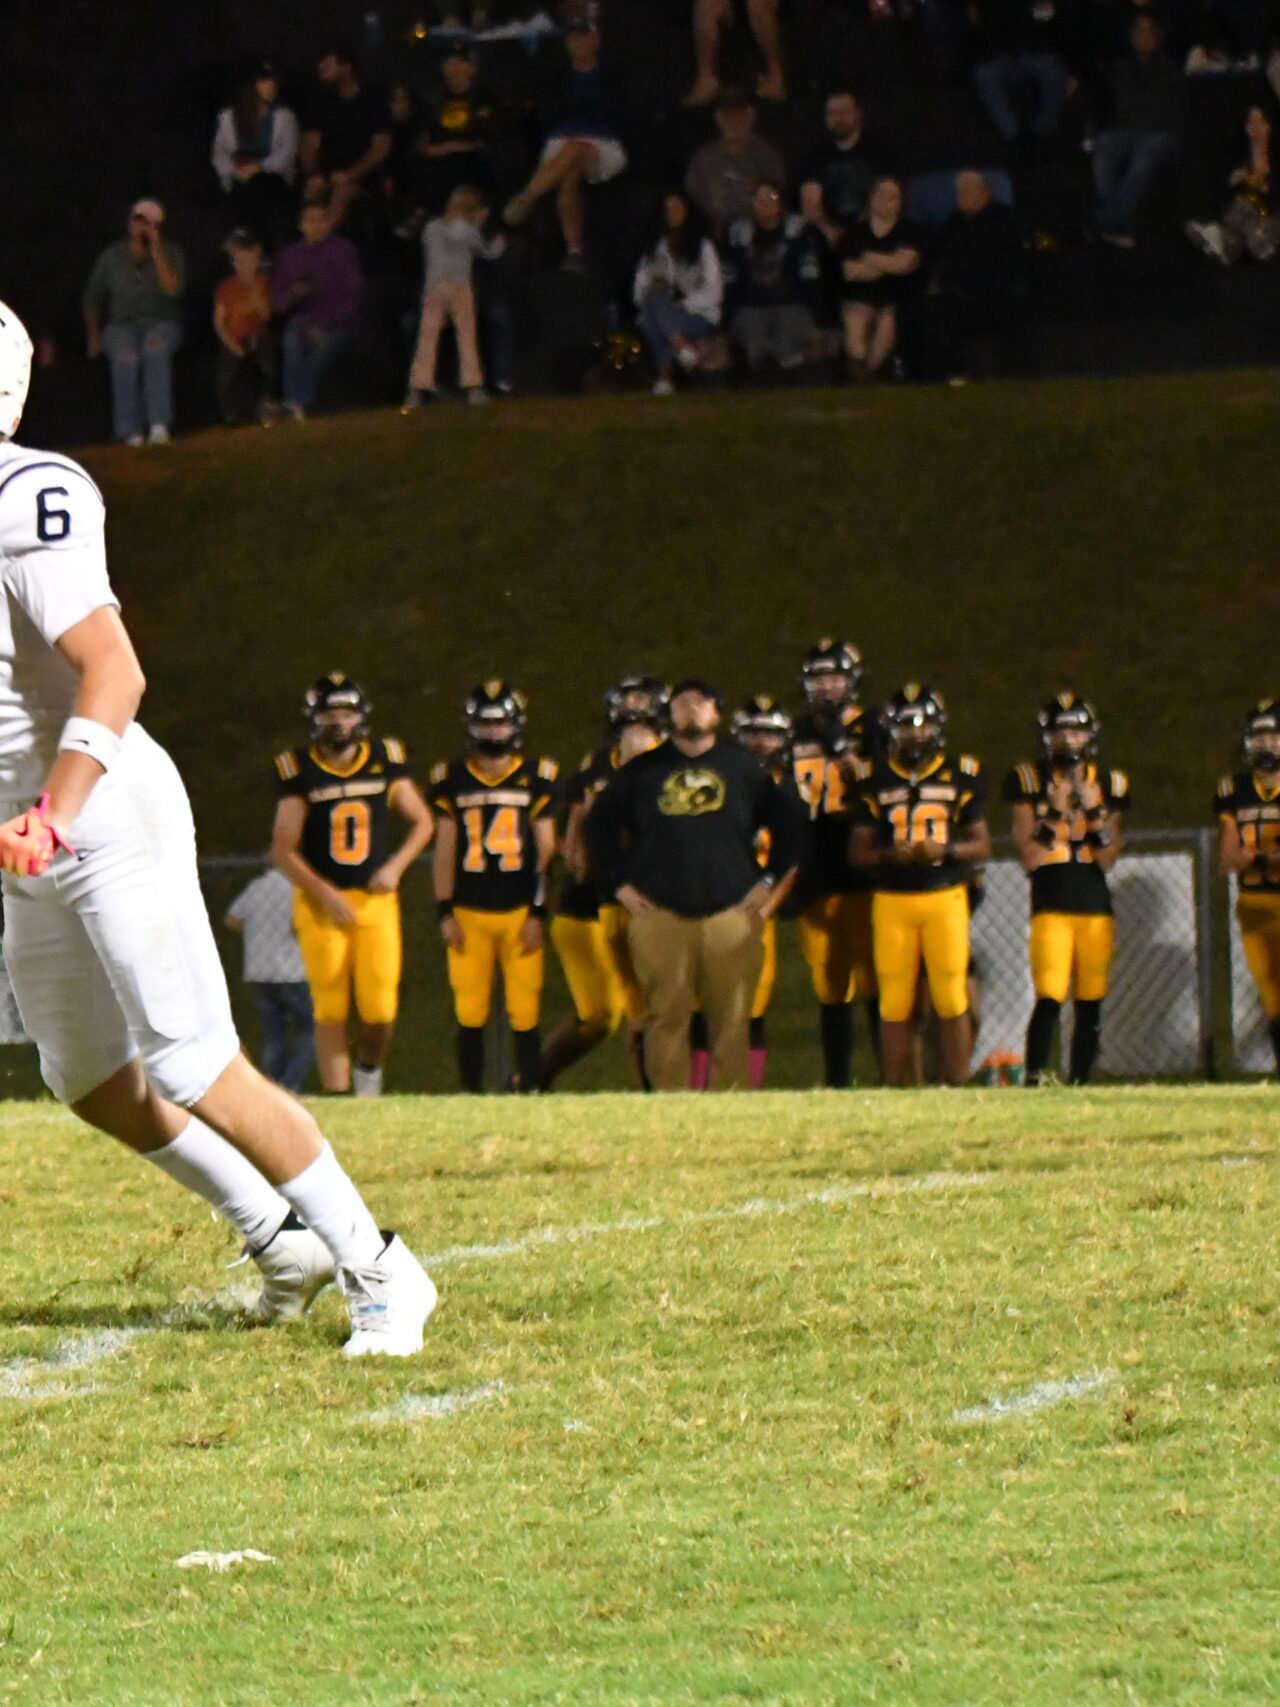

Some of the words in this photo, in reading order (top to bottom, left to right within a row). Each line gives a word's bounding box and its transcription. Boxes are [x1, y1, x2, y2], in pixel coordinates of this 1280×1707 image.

[35, 486, 71, 542] 6
[330, 800, 370, 866] 0
[463, 806, 522, 873] 14
[888, 804, 949, 860] 10
